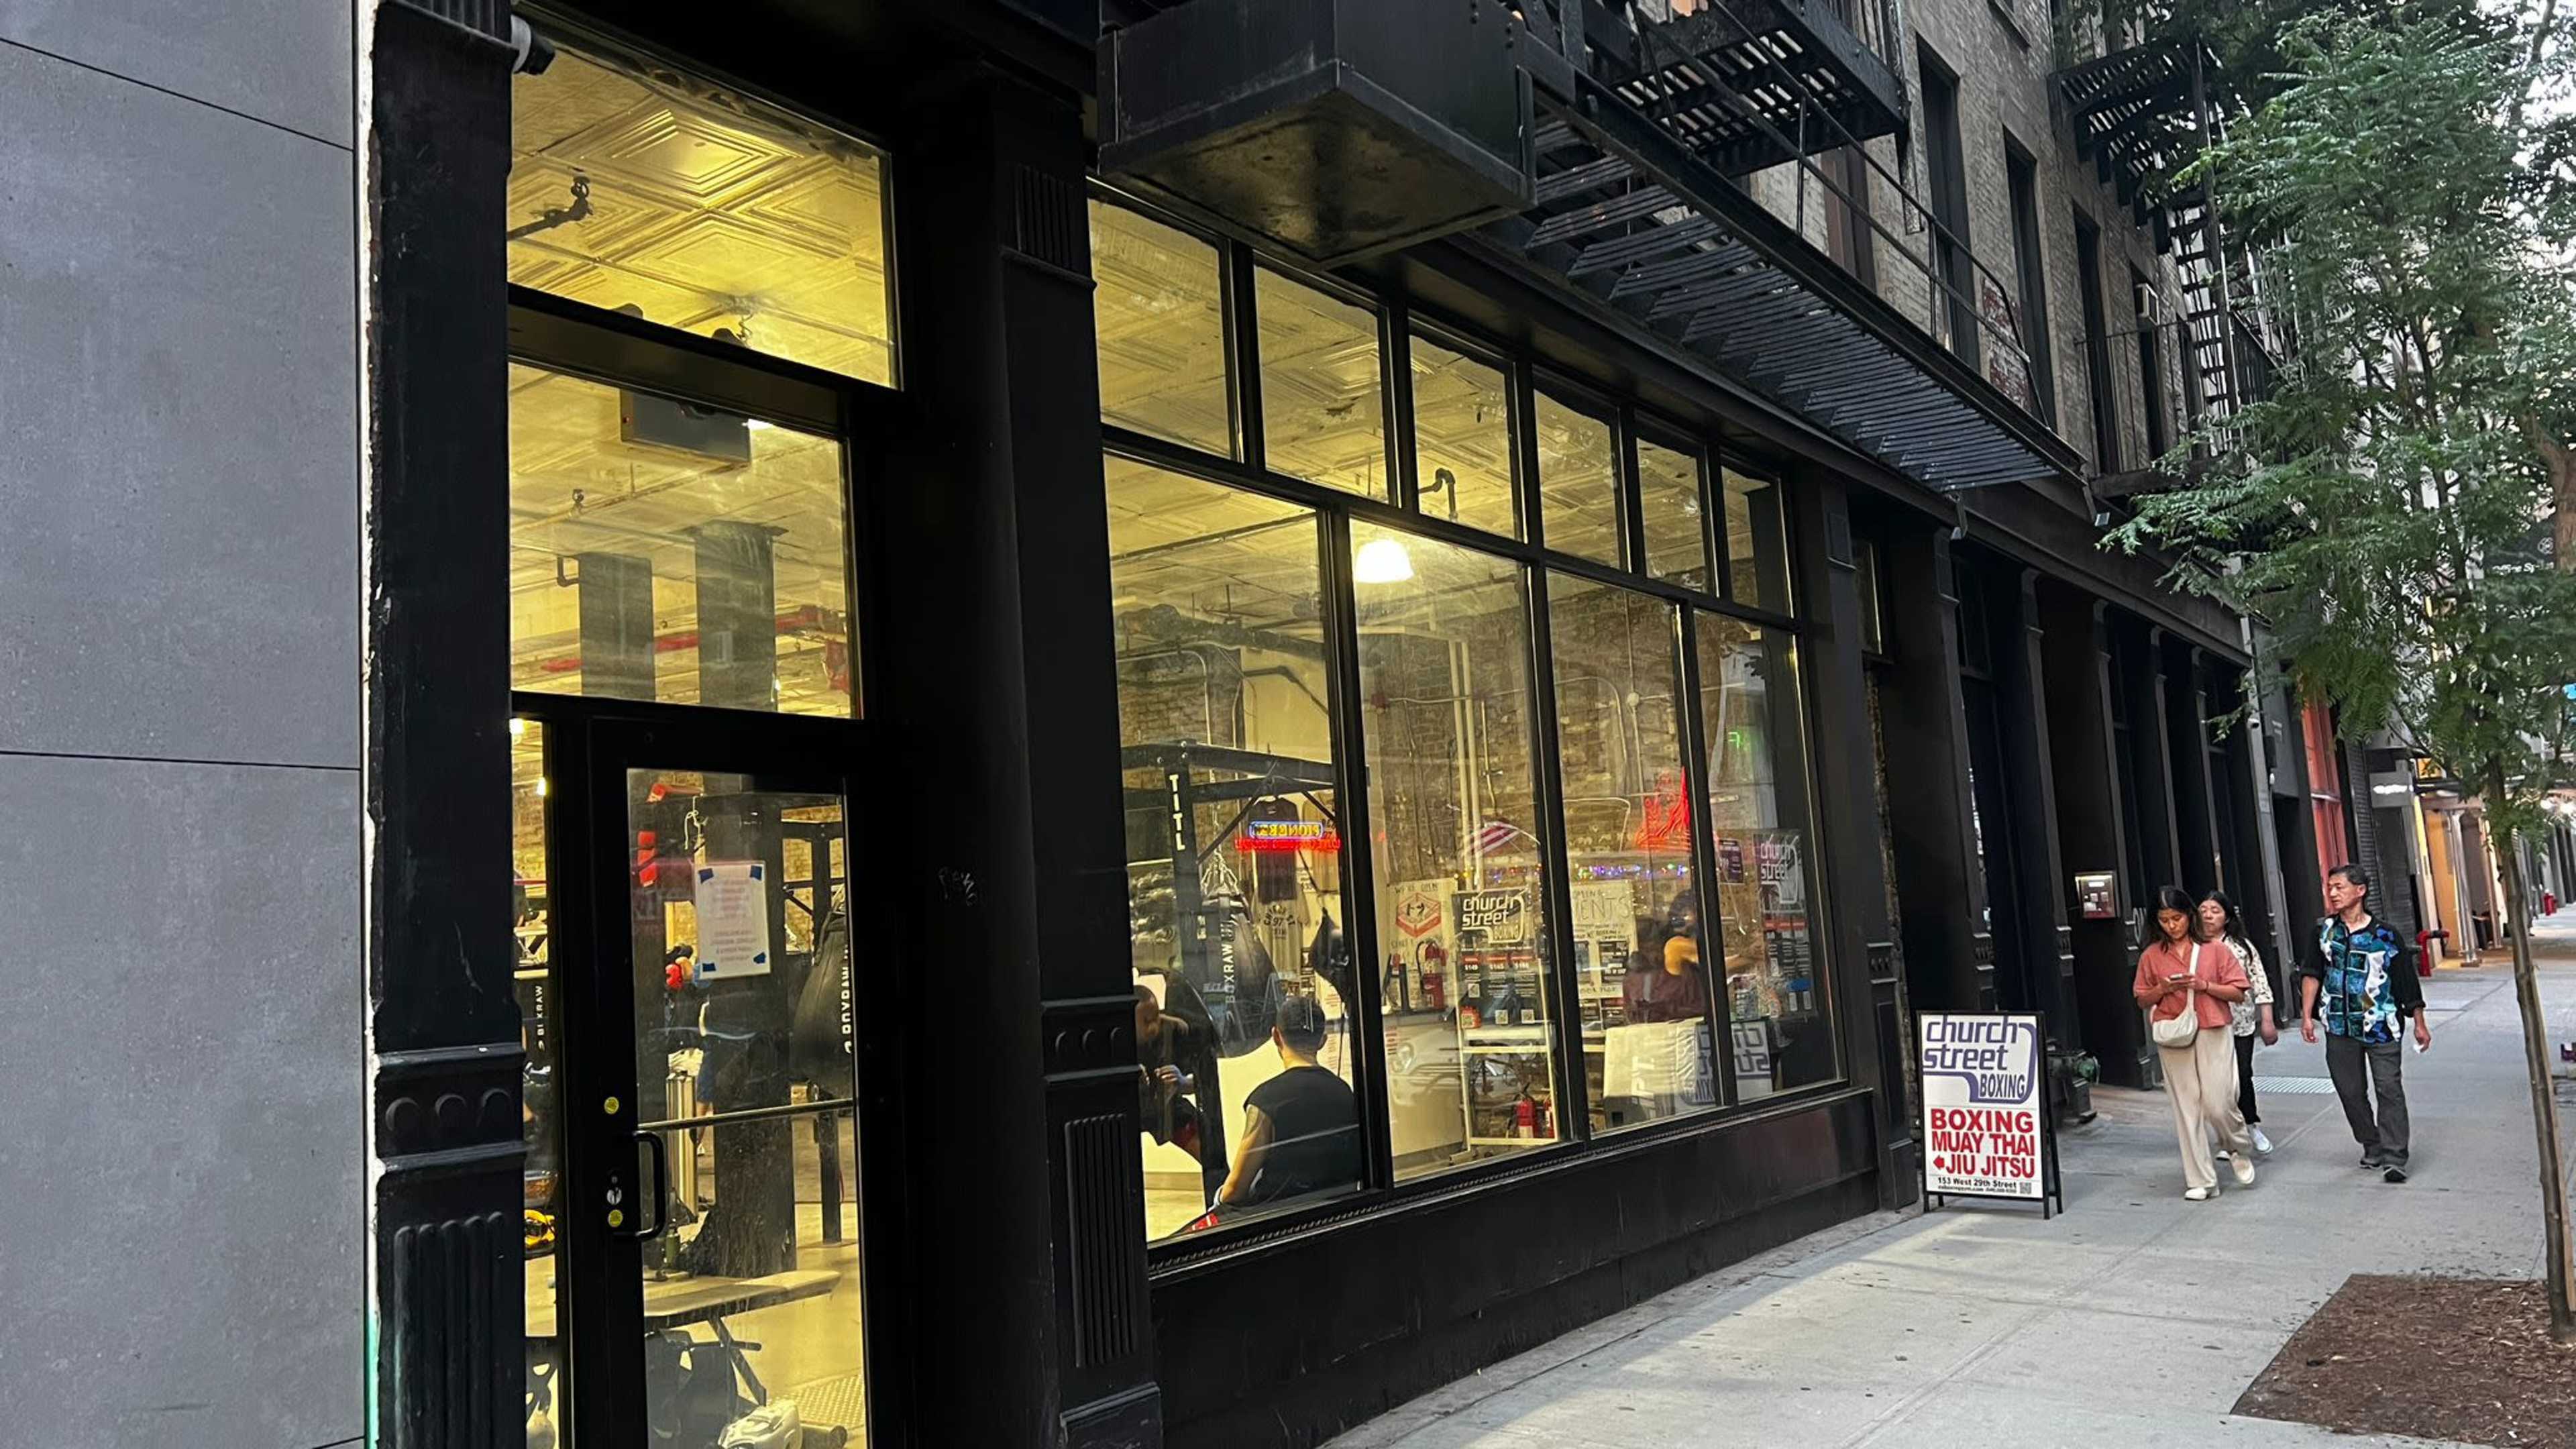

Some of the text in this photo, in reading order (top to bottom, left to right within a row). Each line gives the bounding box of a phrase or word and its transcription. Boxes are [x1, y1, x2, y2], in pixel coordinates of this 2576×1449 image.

[1463, 894, 1513, 911] church
[1462, 911, 1509, 926] street
[1221, 944, 1236, 1004] BOXRAW
[1927, 1015, 2018, 1044] church
[1923, 1044, 2008, 1071] street
[1980, 1074, 2025, 1098] BOXING
[1931, 1109, 2033, 1133] BOXING
[1932, 1131, 2035, 1156] MUAY THAI
[1946, 1155, 2035, 1178] JIU JITSU
[1953, 1178, 1972, 1186] West
[1974, 1179, 1990, 1187] 29th
[1993, 1180, 2017, 1189] Street
